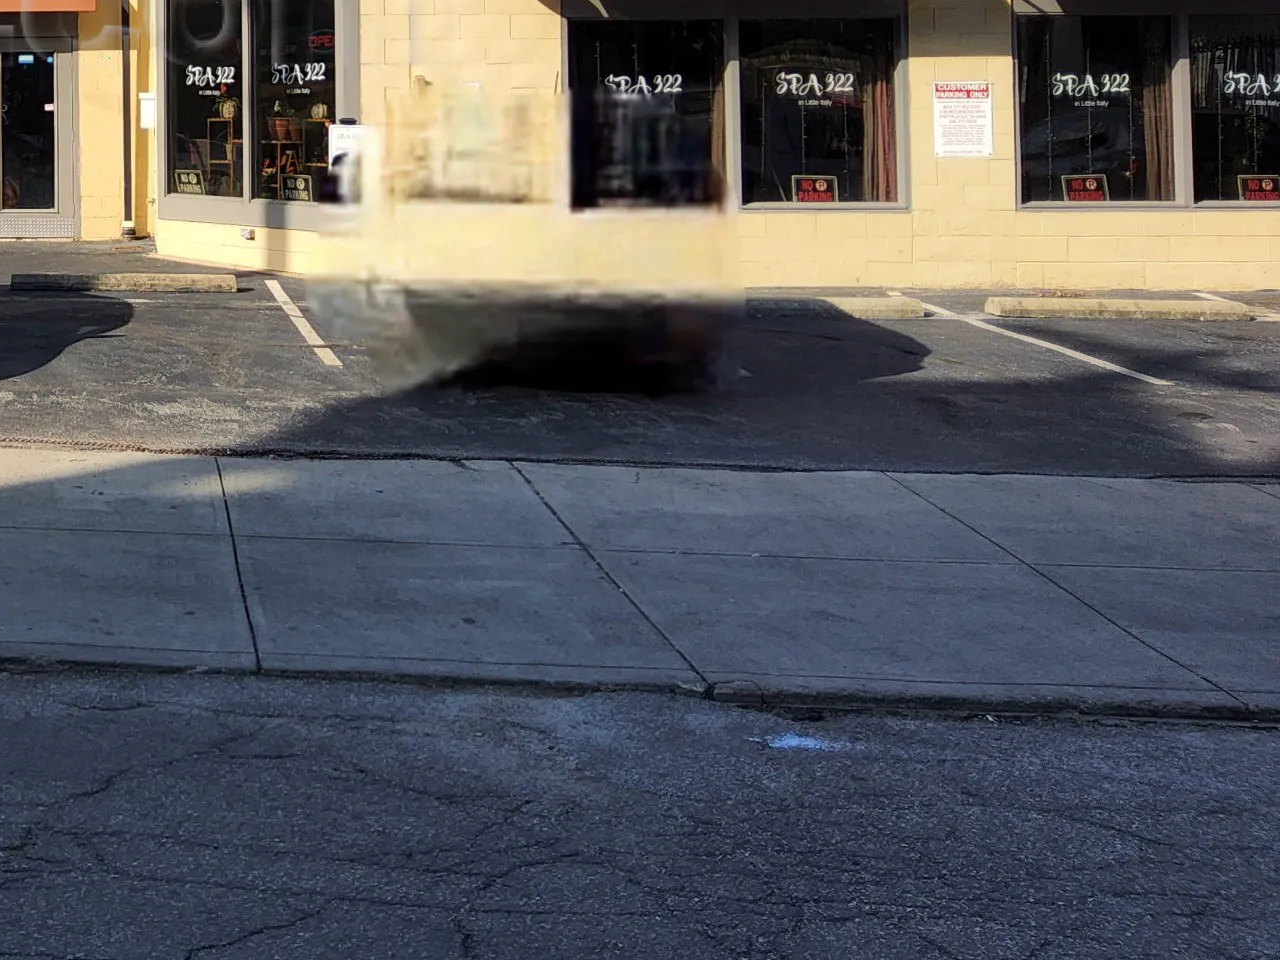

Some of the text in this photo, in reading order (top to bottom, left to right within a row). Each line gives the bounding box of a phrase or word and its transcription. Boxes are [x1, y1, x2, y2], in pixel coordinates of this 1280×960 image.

[308, 35, 335, 47] OPE
[186, 65, 236, 87] SPA 322
[271, 62, 326, 85] SPA 322
[653, 73, 683, 93] 322
[776, 72, 854, 96] SPA 322
[937, 83, 987, 91] CUSTOMER
[1052, 72, 1130, 97] SPA 322
[1224, 71, 1271, 96] SPA
[1096, 100, 1109, 108] Italy
[286, 178, 295, 189] NO
[802, 180, 813, 191] NO
[1072, 179, 1083, 190] NO
[1247, 180, 1259, 190] NO
[285, 189, 309, 200] PARKING
[797, 191, 833, 202] PARKING
[1069, 191, 1104, 201] PARKING
[1245, 191, 1280, 200] PARKING
